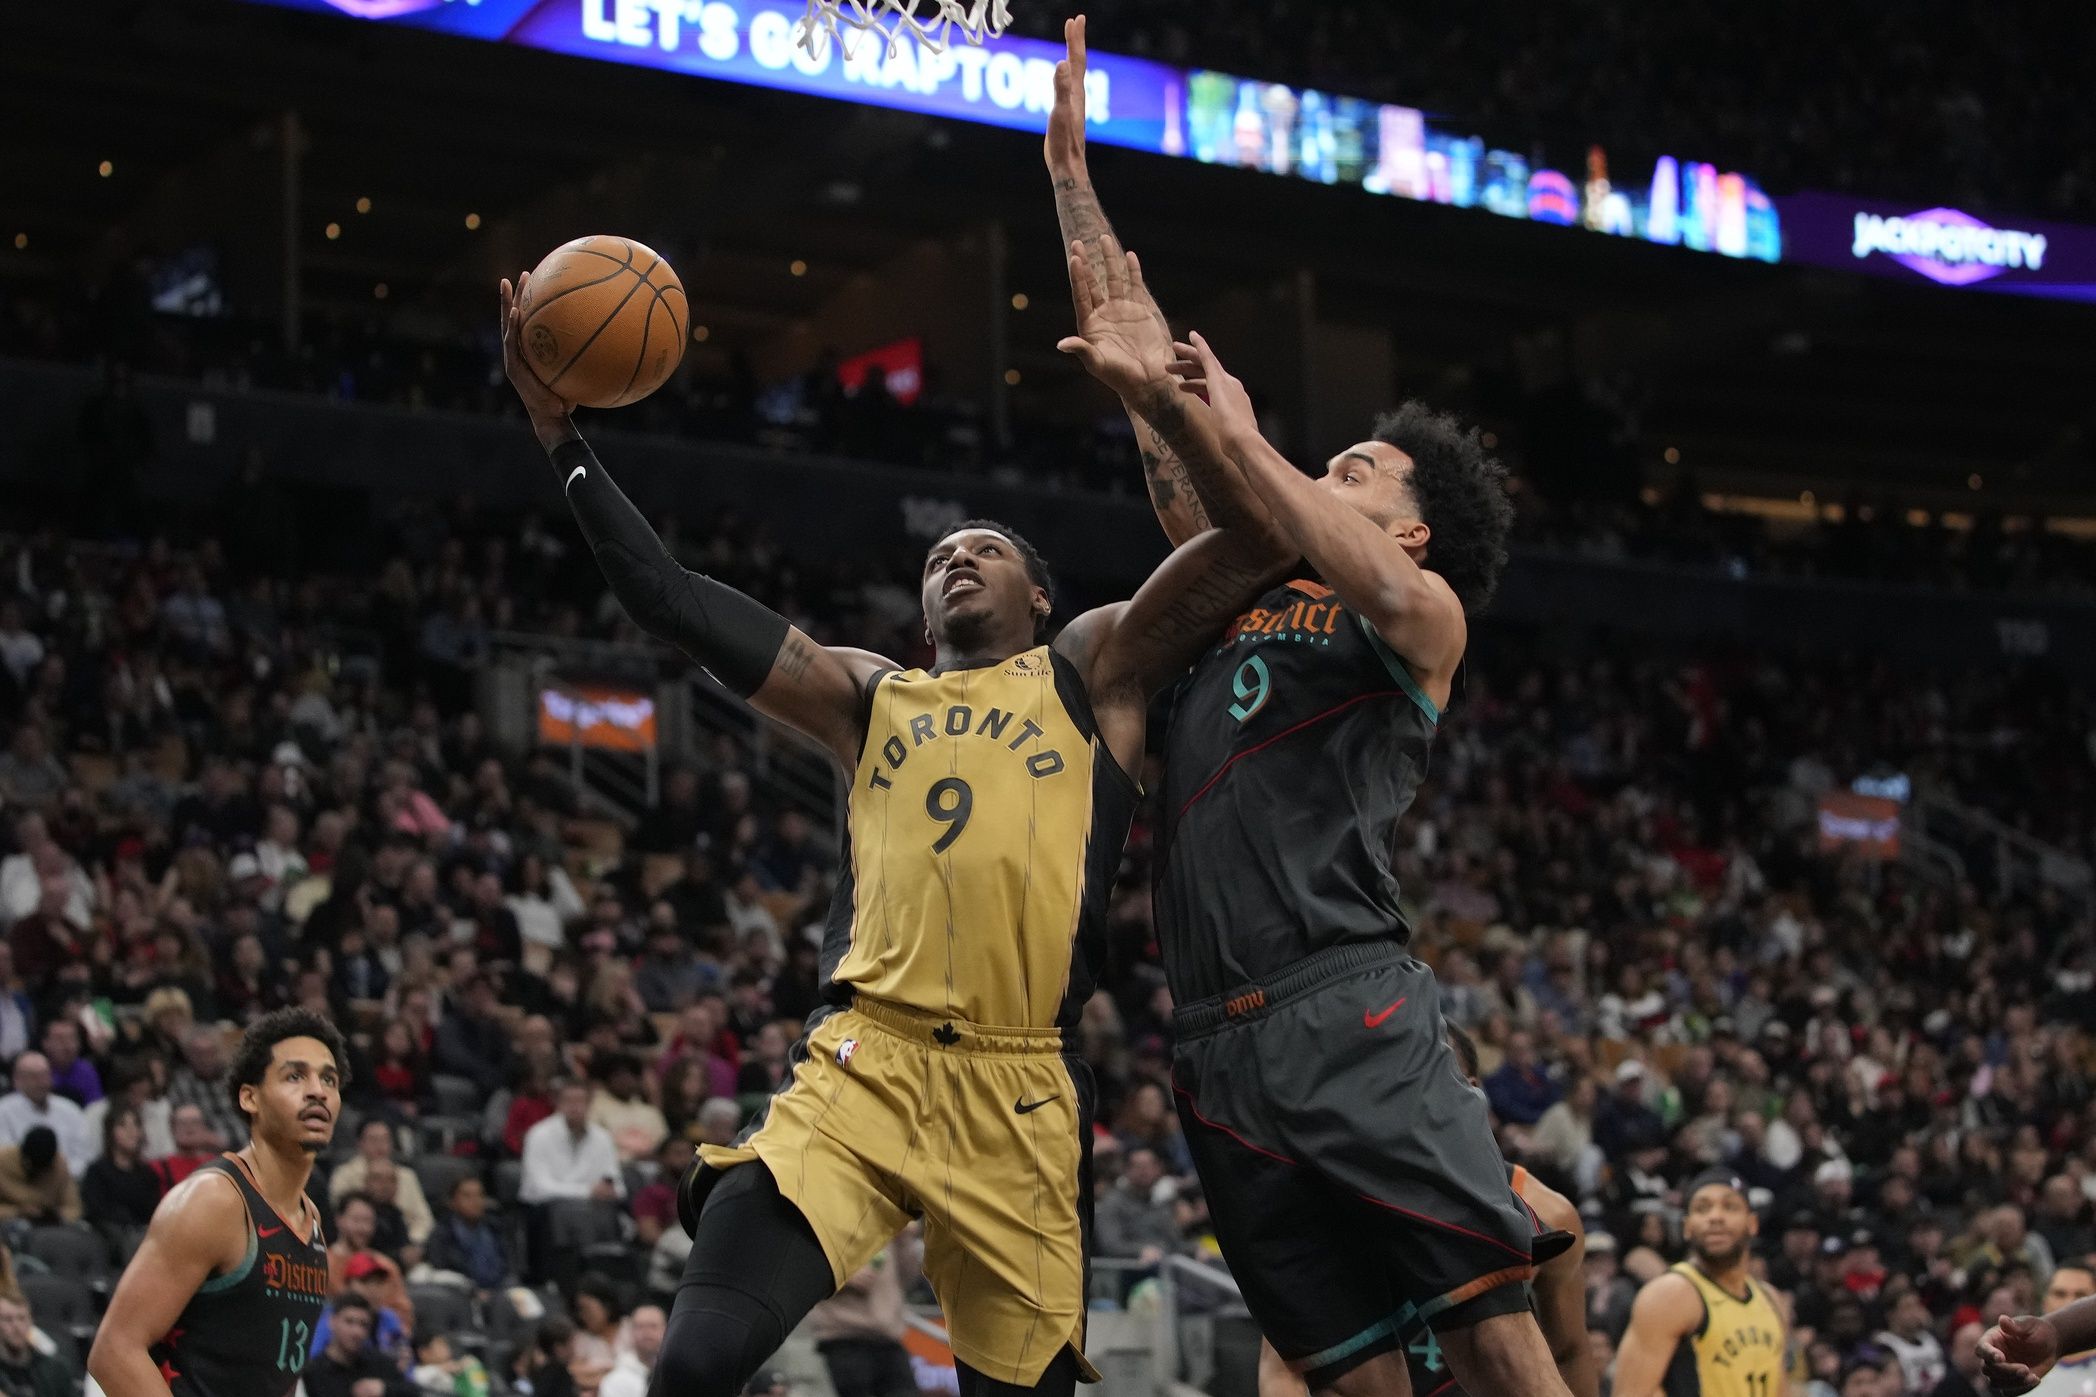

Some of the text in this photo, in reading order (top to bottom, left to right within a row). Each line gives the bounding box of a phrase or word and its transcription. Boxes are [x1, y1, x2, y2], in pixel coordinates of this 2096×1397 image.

[582, 0, 1110, 125] LET'S GO RAPTOR!
[1003, 669, 1027, 677] Sun
[1227, 655, 1271, 724] 9
[868, 704, 1066, 791] TORONTO
[924, 775, 974, 856] 9
[276, 1317, 309, 1374] 13
[1746, 1371, 1768, 1397] 11
